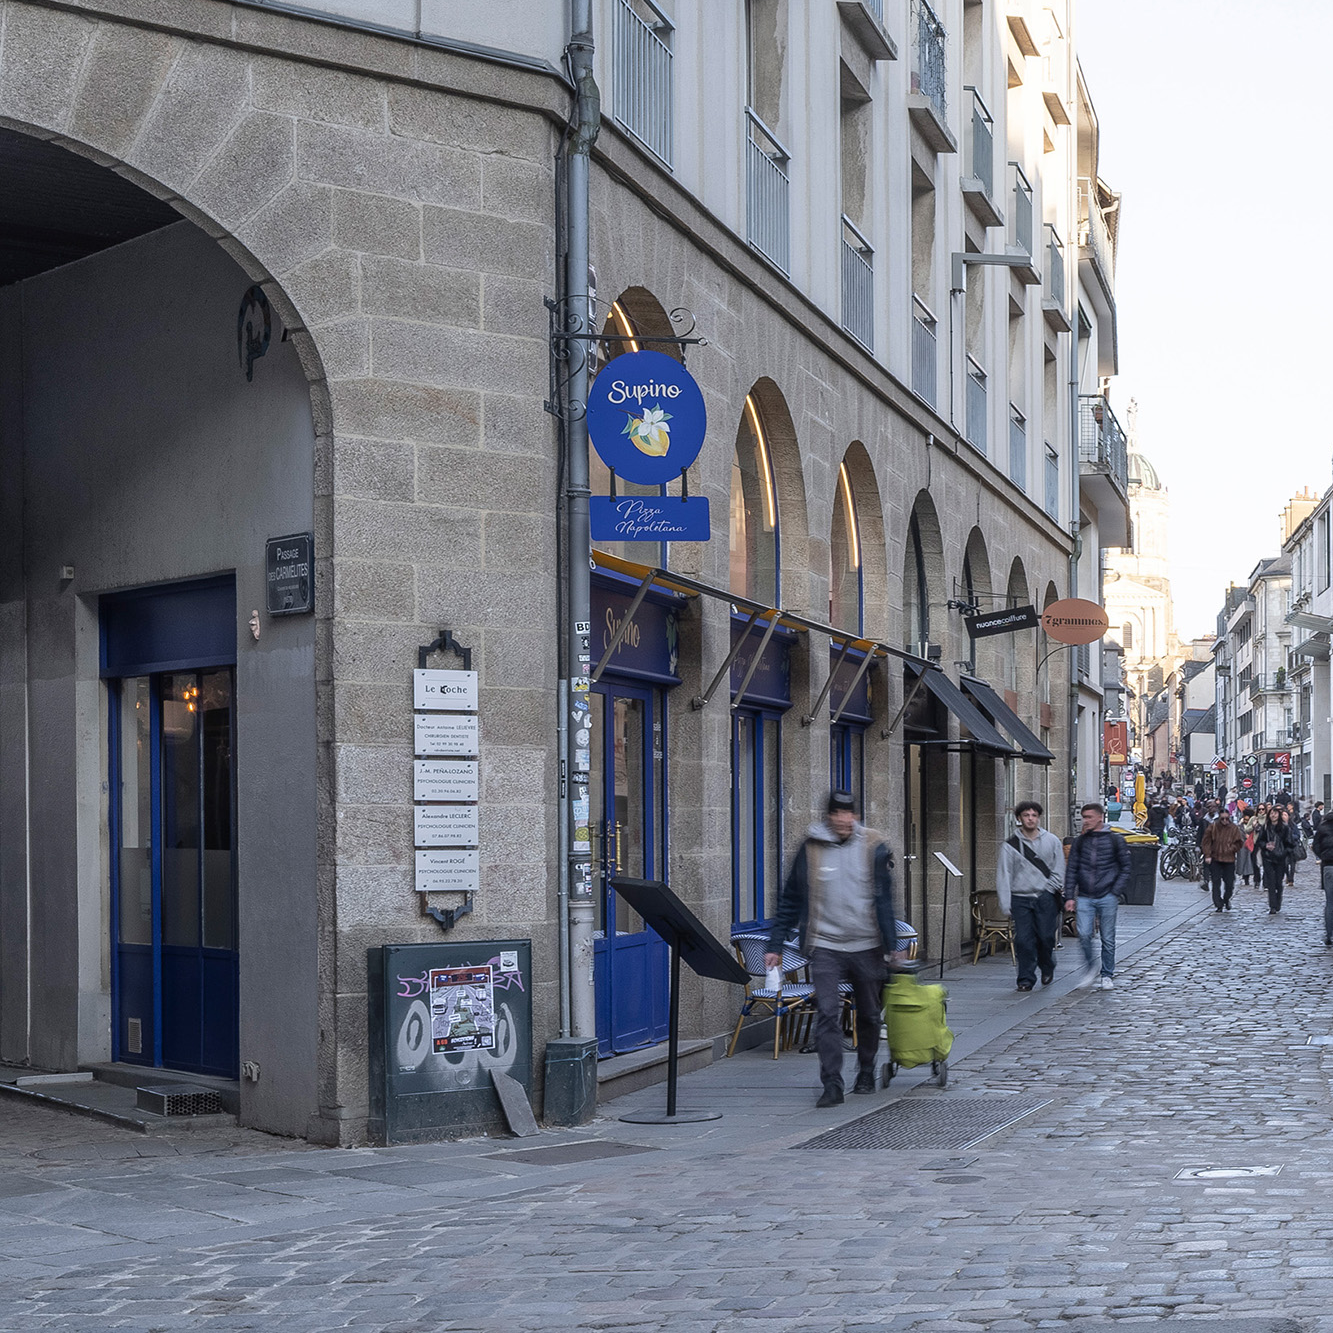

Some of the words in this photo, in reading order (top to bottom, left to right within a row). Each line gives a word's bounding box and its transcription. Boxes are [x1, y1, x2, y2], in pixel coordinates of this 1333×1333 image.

[607, 379, 683, 405] Supino
[616, 499, 664, 523] Pizza
[615, 519, 688, 538] Napoletana
[425, 685, 436, 693] Le
